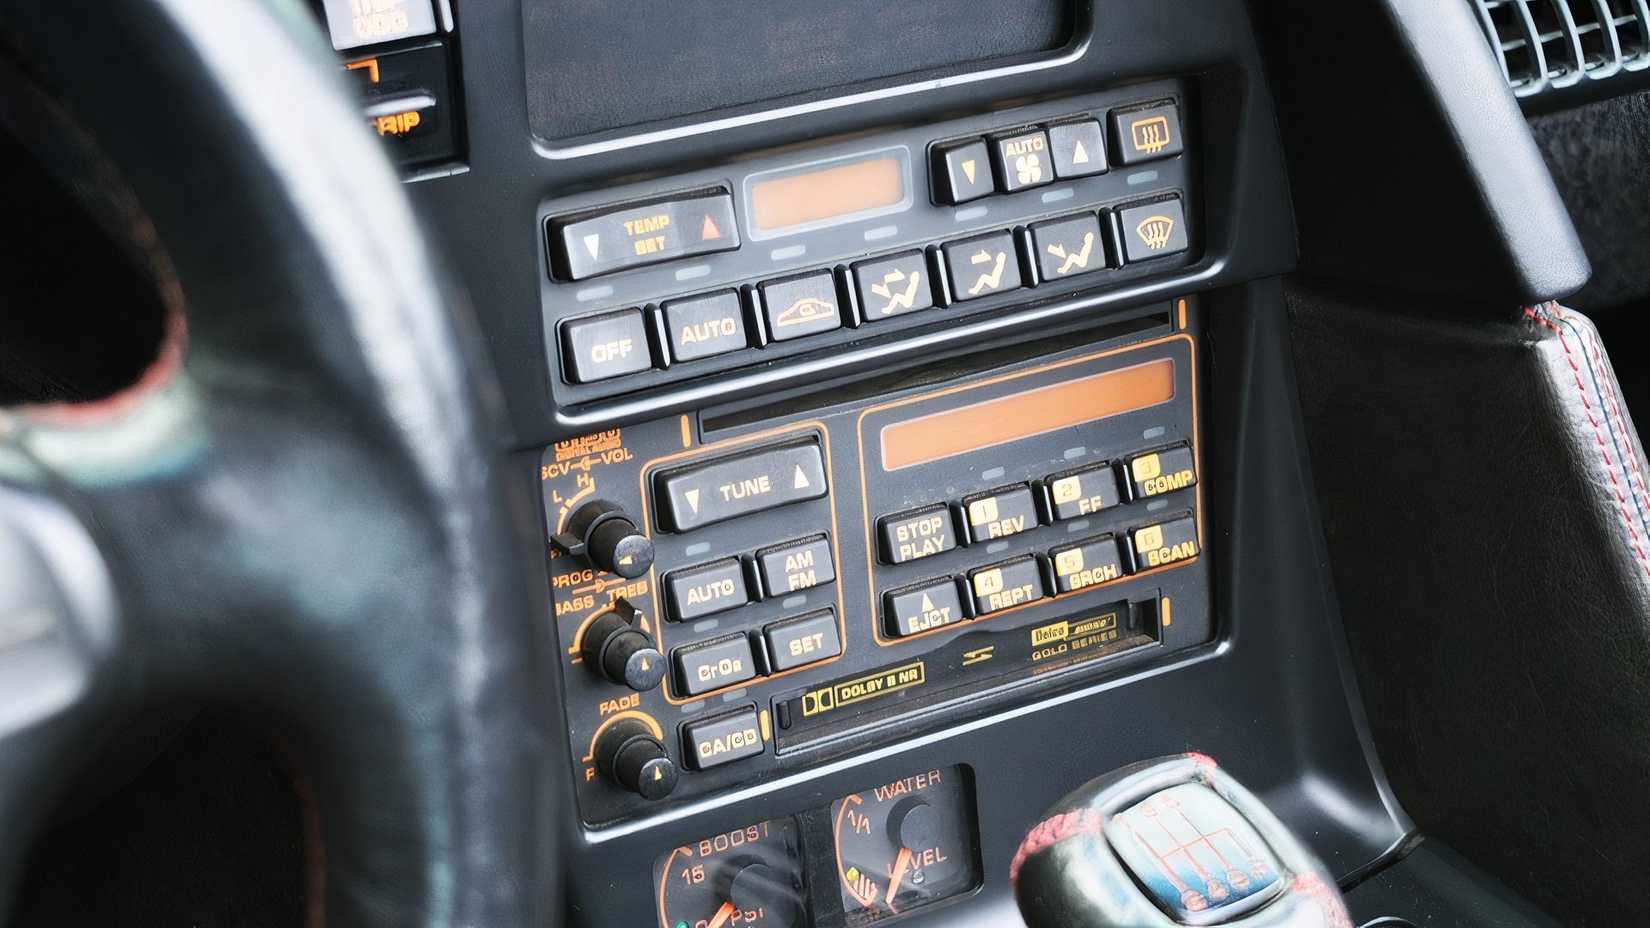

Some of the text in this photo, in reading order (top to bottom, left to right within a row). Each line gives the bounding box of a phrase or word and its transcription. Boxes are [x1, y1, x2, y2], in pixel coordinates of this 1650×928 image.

[375, 111, 420, 136] RIP
[1006, 137, 1043, 156] AUTO
[624, 215, 670, 236] TEMP
[680, 317, 736, 345] AUTO
[591, 339, 632, 363] OFF
[601, 448, 633, 465] VOL
[720, 475, 771, 502] TUNE
[1144, 470, 1193, 496] COMP
[553, 490, 562, 503] L
[1079, 496, 1102, 516] FF
[896, 516, 943, 542] STOP
[988, 515, 1025, 539] REV
[900, 535, 945, 561] PLAY
[1148, 541, 1195, 566] SCAN
[785, 550, 813, 573] AM
[607, 581, 648, 601] TREB
[688, 578, 735, 606] AUTO
[788, 569, 816, 591] FM
[989, 585, 1033, 611] REPT
[908, 607, 950, 634] EJCT
[789, 632, 824, 656] SET
[841, 678, 883, 700] DOLBY
[899, 669, 918, 684] NR
[600, 693, 640, 715] FADE
[699, 729, 758, 758] CA/CD
[874, 770, 941, 802] WATER
[848, 809, 871, 835] 1/1
[700, 821, 769, 857] BOOST
[682, 864, 705, 885] 15
[887, 847, 948, 879] LVEL
